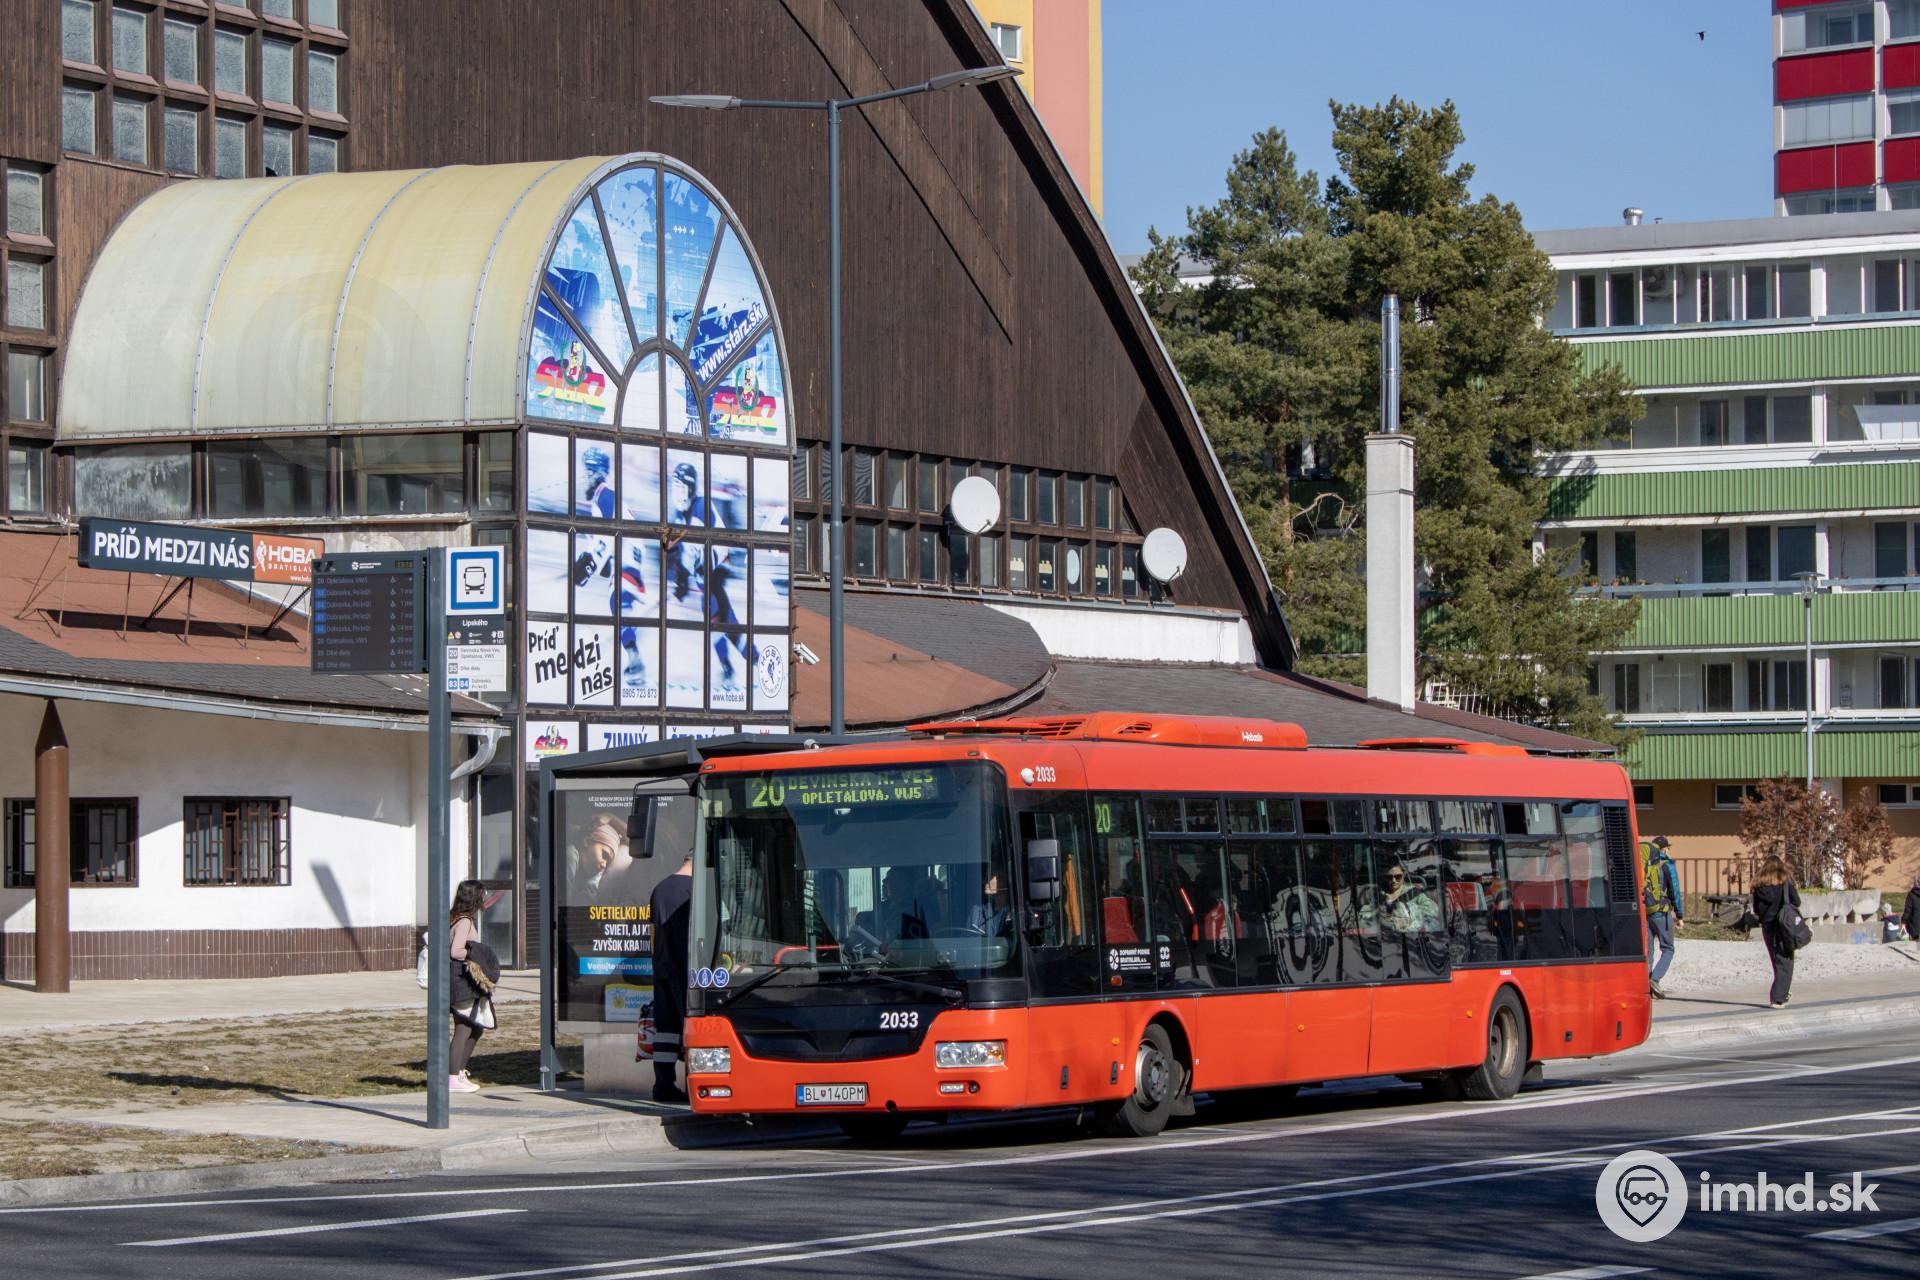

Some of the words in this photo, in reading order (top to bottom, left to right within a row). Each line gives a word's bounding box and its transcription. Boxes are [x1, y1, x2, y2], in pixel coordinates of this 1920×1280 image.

[696, 302, 763, 381] www.starz.sk
[94, 527, 140, 559] PRÍĎ
[144, 536, 205, 565] MEDZI
[210, 538, 250, 569] NÁS
[268, 545, 316, 564] HOBA
[528, 626, 559, 652] Príď
[448, 649, 458, 658] 20
[535, 634, 601, 683] medzi
[581, 662, 613, 696] nás
[622, 688, 635, 698] 0905
[636, 688, 646, 698] 723
[1035, 766, 1056, 783] 2033
[752, 777, 785, 807] 20
[1094, 803, 1111, 833] 20
[590, 906, 637, 920] SVETIELKO
[604, 923, 631, 937] SVIETI,
[632, 924, 640, 936] AJ
[592, 937, 623, 951] ZVYŠOK
[587, 962, 616, 971] Venujte
[880, 1011, 919, 1029] 2033
[805, 1087, 820, 1101] BL
[828, 1087, 864, 1100] 140PM
